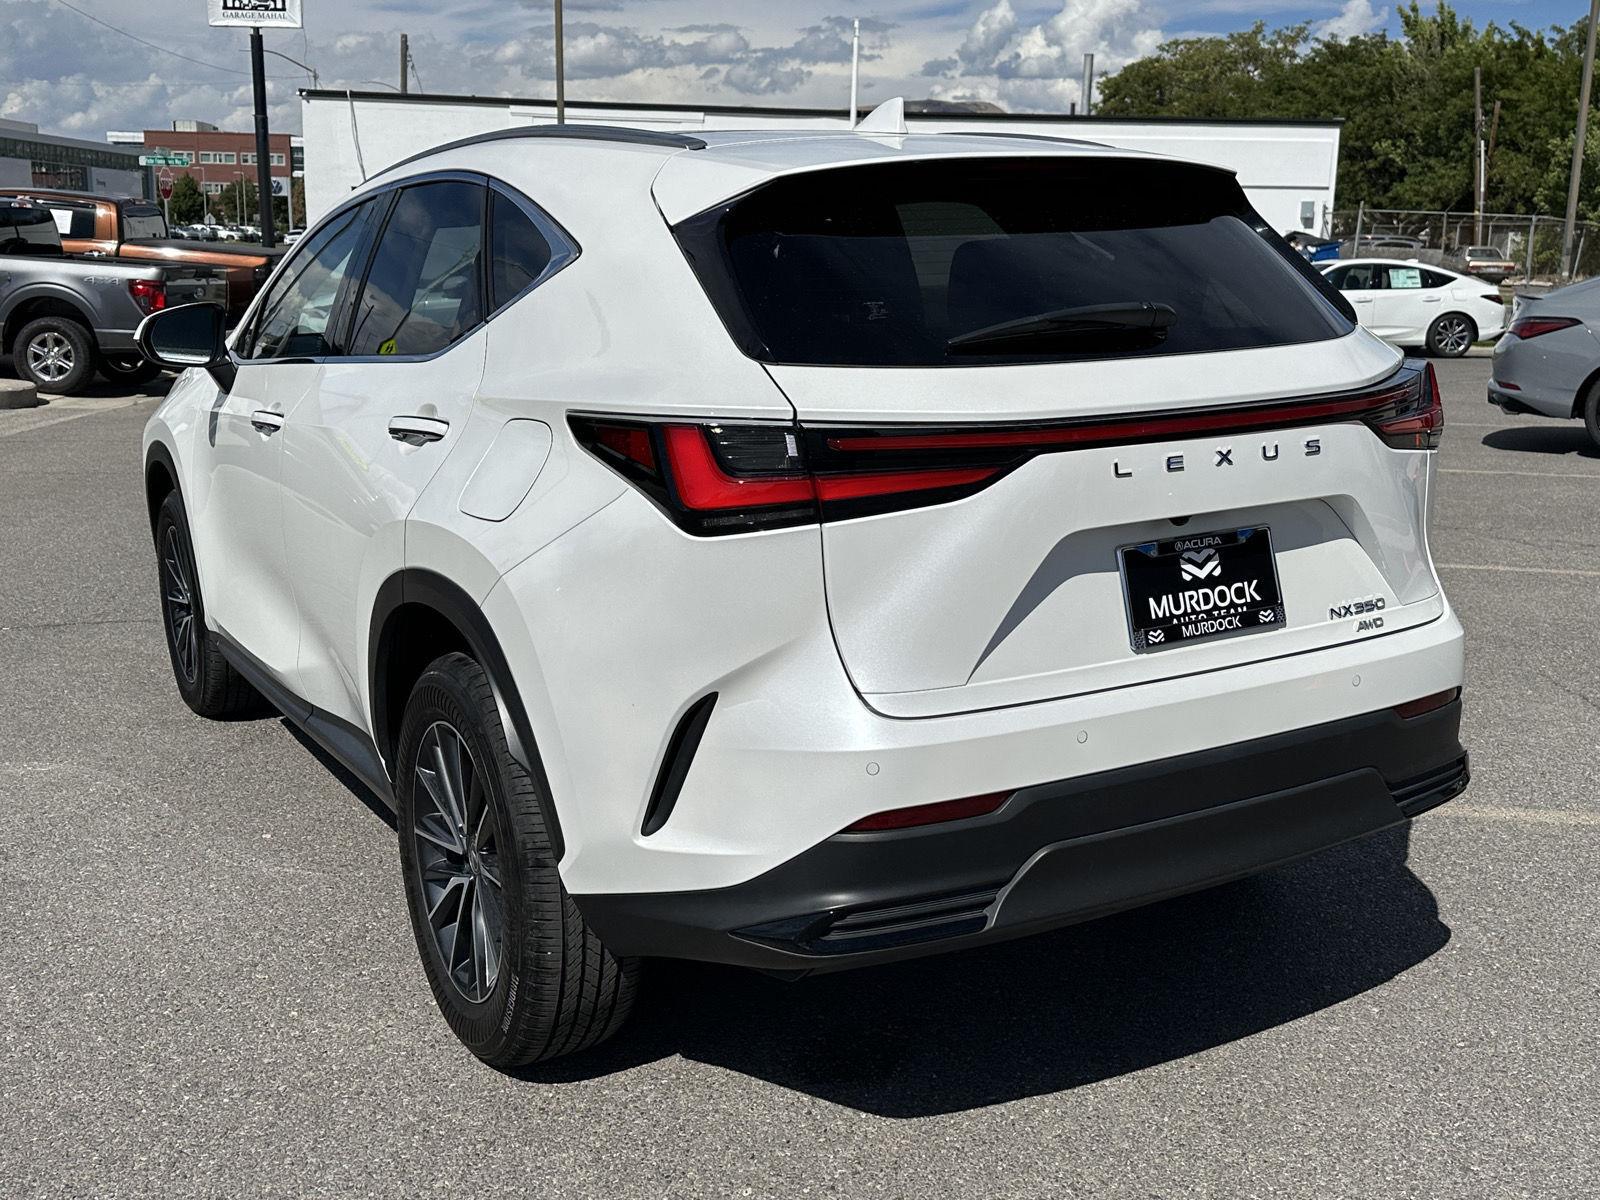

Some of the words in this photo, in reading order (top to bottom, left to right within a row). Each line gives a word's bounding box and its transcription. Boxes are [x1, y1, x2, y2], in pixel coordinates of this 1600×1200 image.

[222, 11, 255, 19] GARAGE
[258, 12, 287, 20] MAHAL
[1113, 438, 1322, 479] LEXUS
[1183, 536, 1222, 551] ACURA
[1149, 579, 1262, 620] MURDOCK
[1329, 597, 1386, 620] NX350
[1181, 615, 1242, 638] MURDOCK
[1356, 617, 1384, 632] AWD
